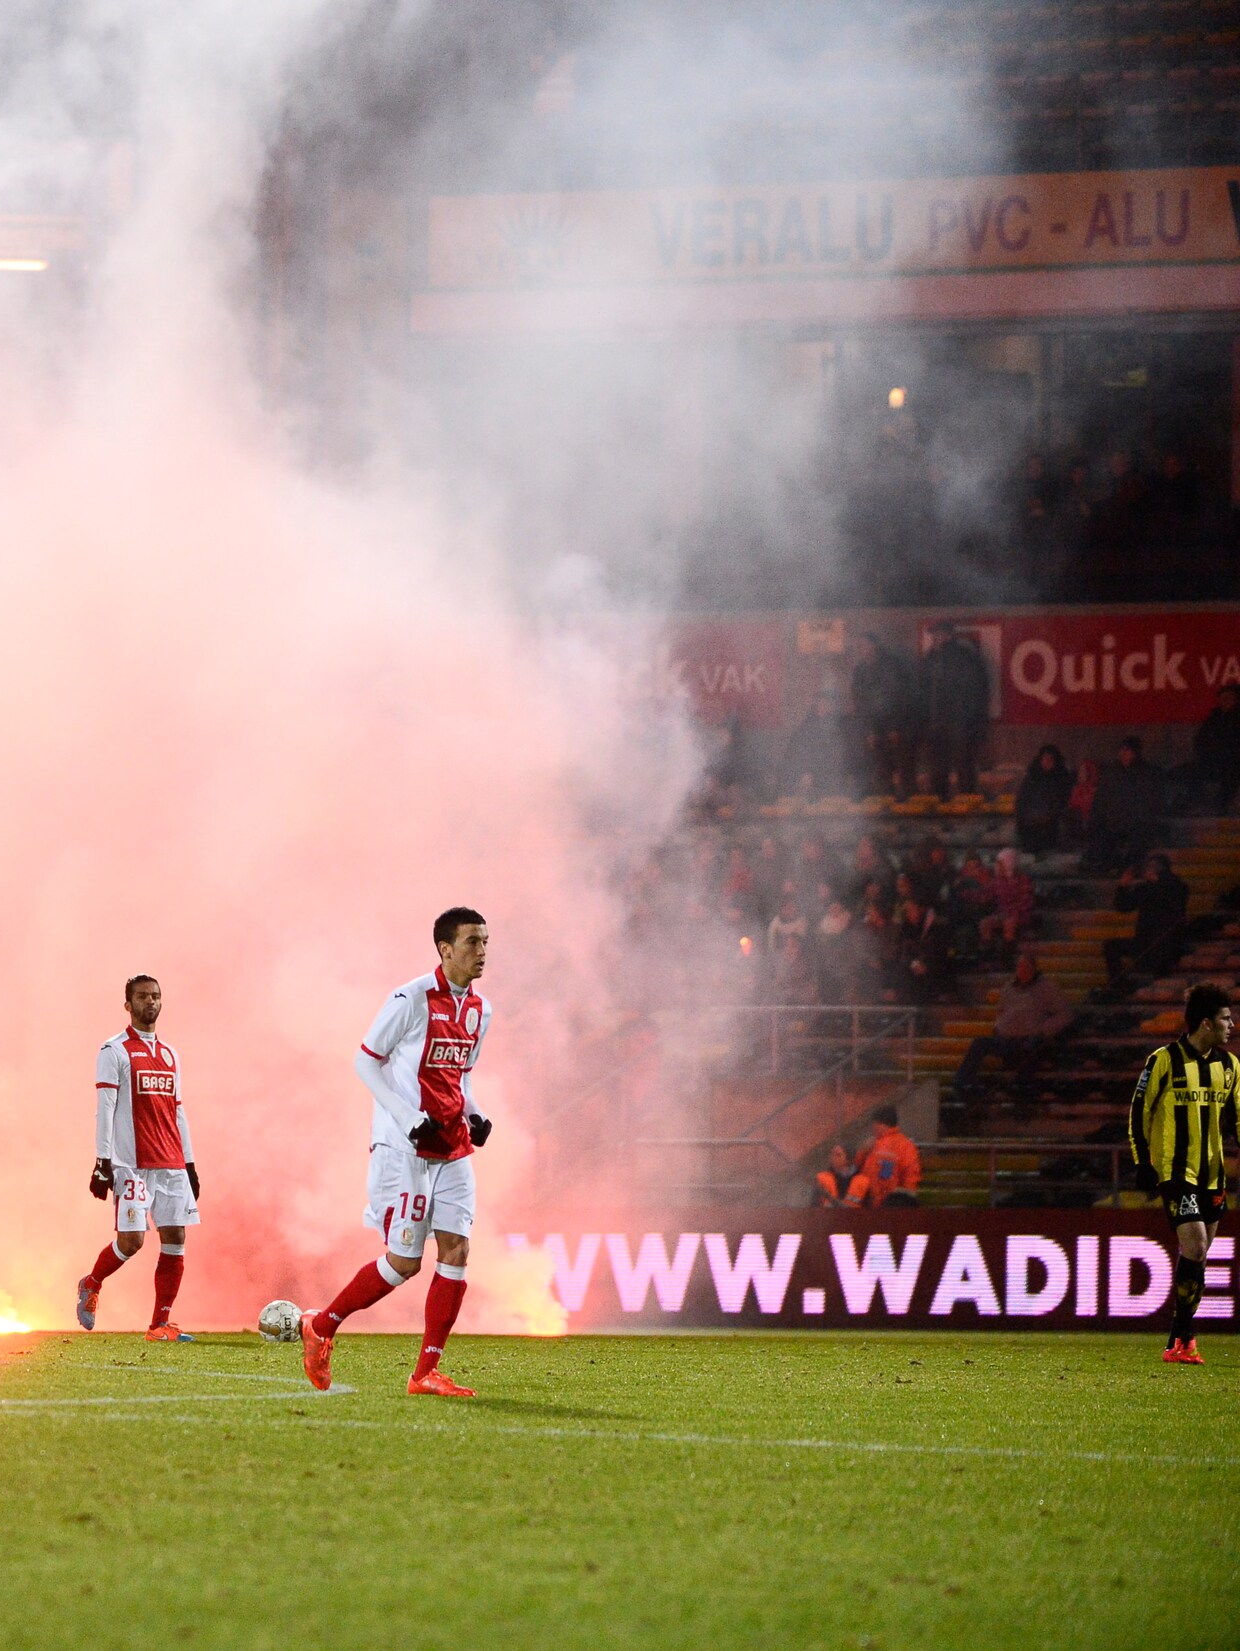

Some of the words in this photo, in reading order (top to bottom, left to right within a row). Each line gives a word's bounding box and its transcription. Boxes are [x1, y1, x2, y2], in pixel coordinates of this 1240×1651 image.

[649, 194, 894, 268] VERALU
[927, 194, 1033, 254] PVC
[1083, 188, 1190, 248] ALU
[698, 663, 767, 693] VAK
[1009, 632, 1190, 706] Quick
[432, 1045, 469, 1063] BASE
[141, 1076, 173, 1090] BASE
[1174, 1090, 1201, 1102] WADI
[123, 1178, 147, 1202] 33
[399, 1191, 427, 1223] 19
